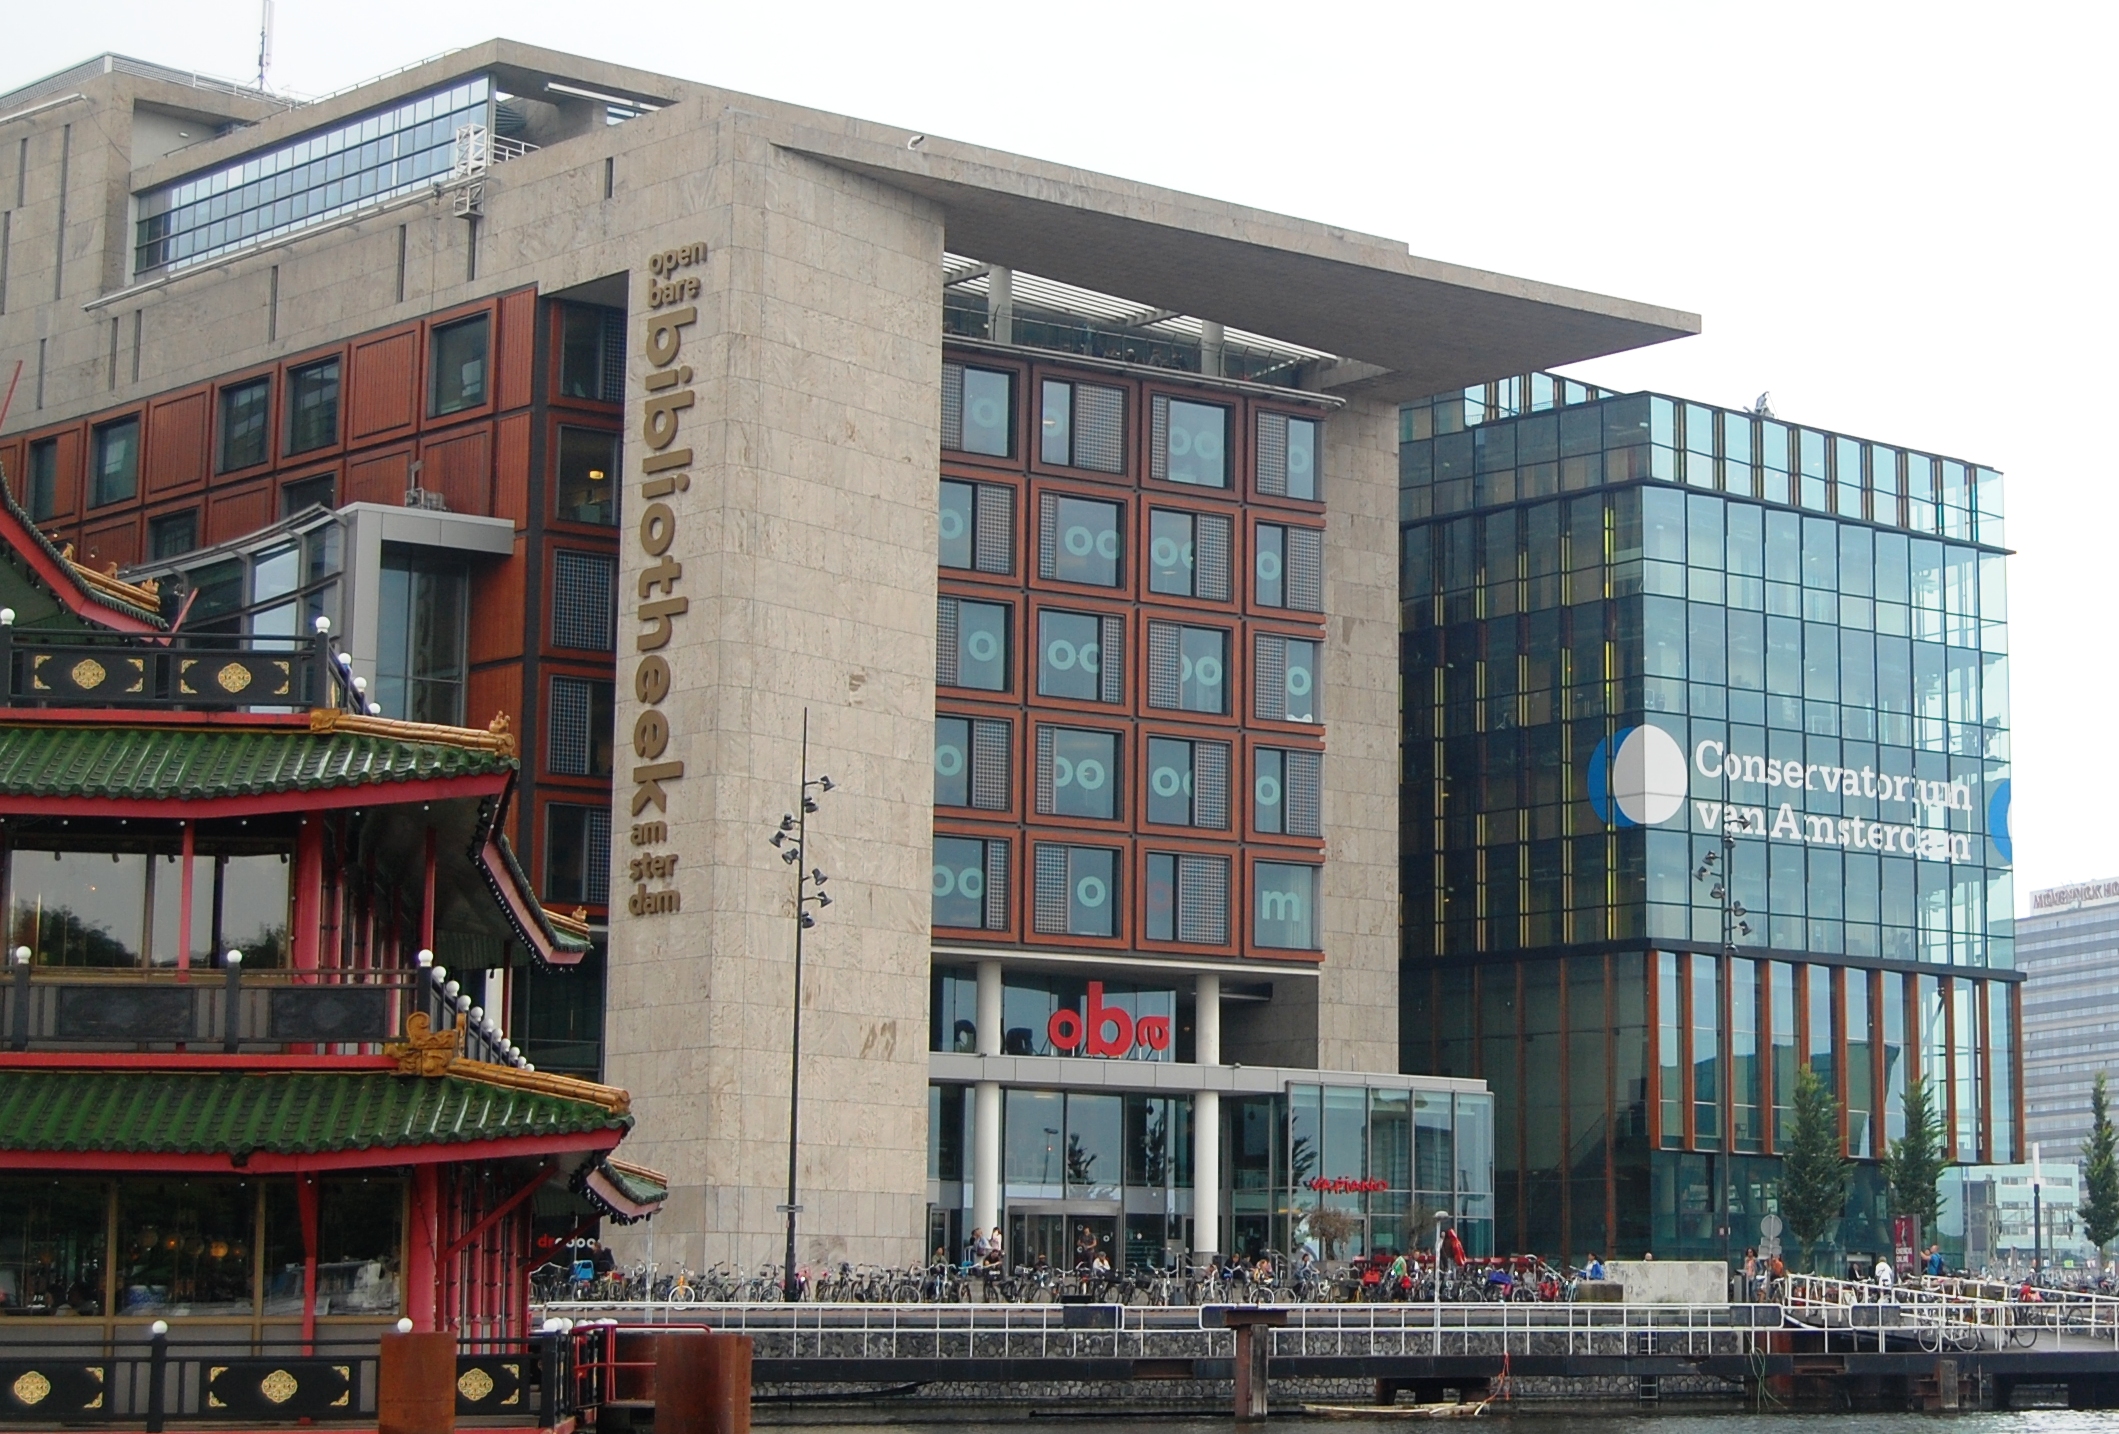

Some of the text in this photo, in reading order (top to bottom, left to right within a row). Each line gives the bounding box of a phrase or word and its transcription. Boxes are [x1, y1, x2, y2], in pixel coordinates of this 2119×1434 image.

[649, 241, 707, 280] open
[648, 277, 701, 309] bare
[632, 306, 697, 817] bibliotheek
[1695, 739, 1973, 811] Conservatorium
[630, 820, 668, 846] am
[1696, 802, 1972, 861] van Amsterdam
[629, 852, 679, 882] ster
[628, 883, 681, 916] dam
[1048, 981, 1170, 1057] oba
